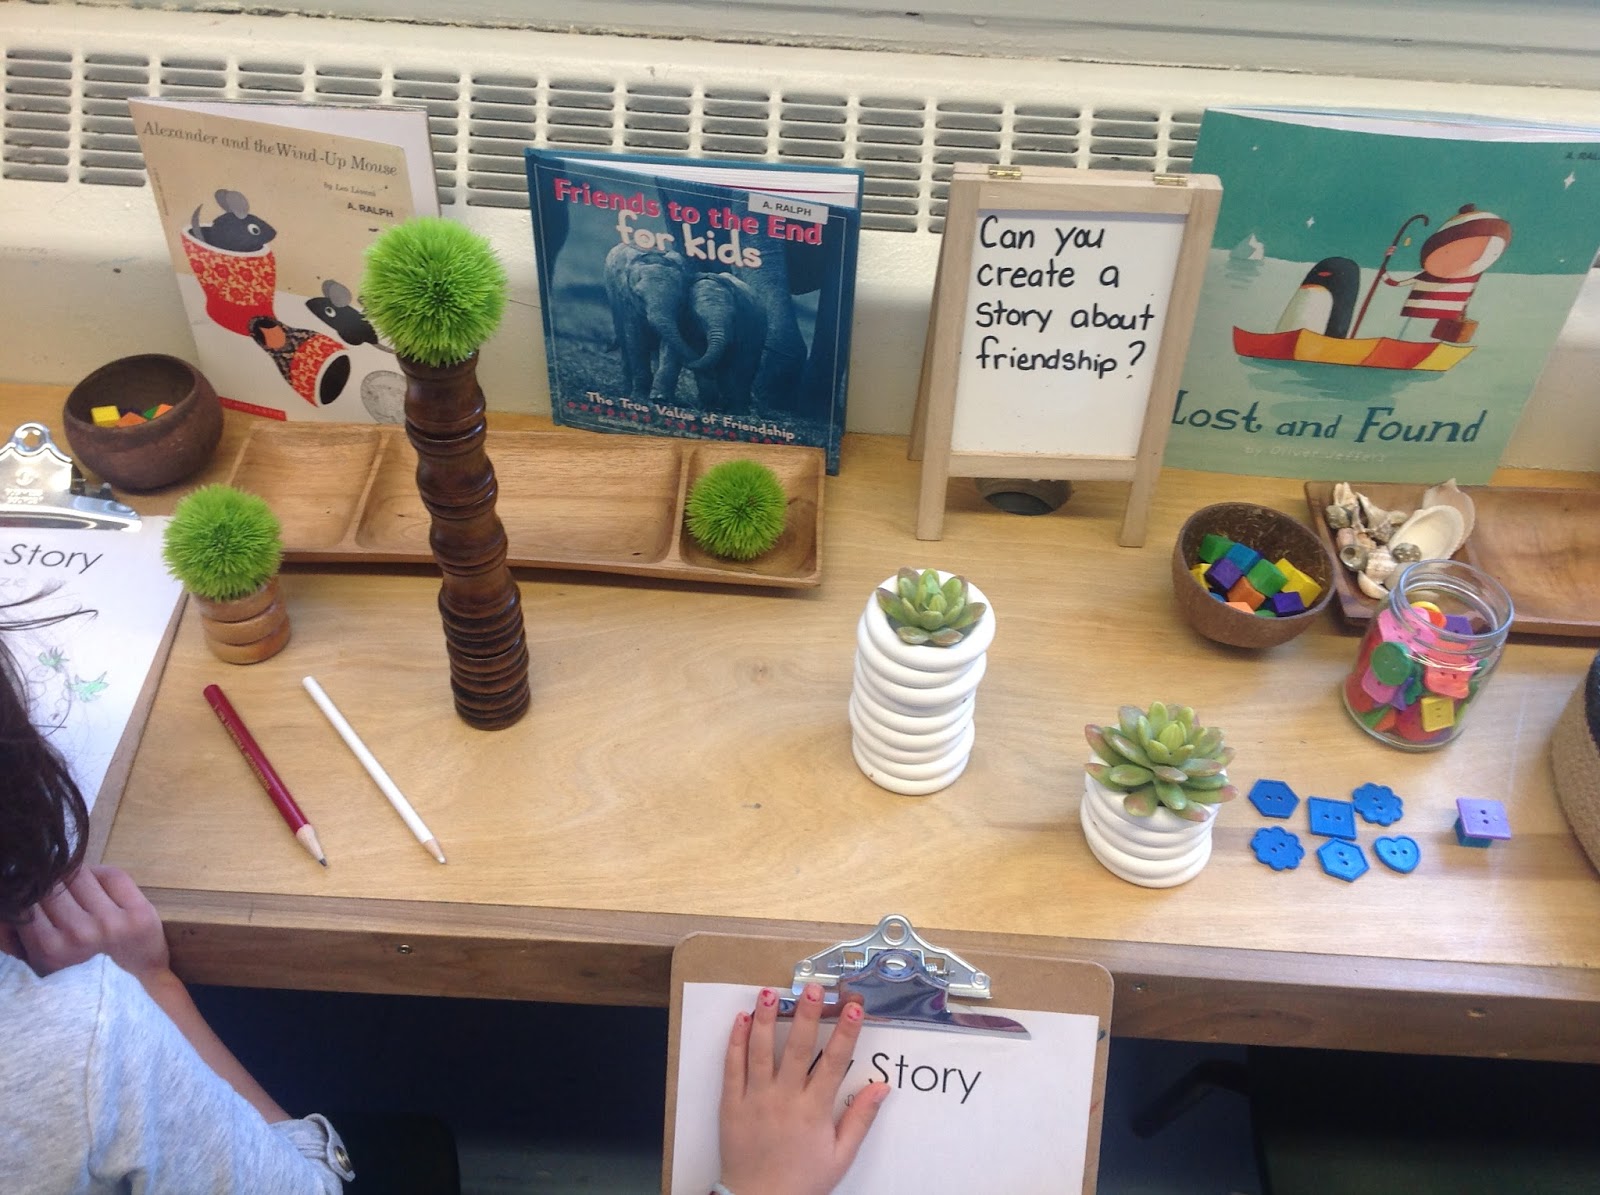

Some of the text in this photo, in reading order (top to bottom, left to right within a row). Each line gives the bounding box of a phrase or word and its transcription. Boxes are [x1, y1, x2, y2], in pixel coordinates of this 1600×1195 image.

[142, 121, 398, 176] Alexander and the Wind-Up Mouse
[347, 202, 394, 217] A. RALPH
[553, 177, 823, 246] Friends to the End
[762, 202, 811, 217] A. RALPH
[617, 210, 763, 268] for kids
[980, 215, 1105, 256] Can you
[977, 258, 1119, 288] create a
[1070, 303, 1155, 330] about
[586, 391, 614, 406] The
[619, 398, 649, 413] True
[654, 404, 696, 422] Value
[702, 414, 719, 425] of
[722, 416, 795, 442] Friendship
[1171, 390, 1488, 444] Lost and Found
[3, 543, 104, 575] Story
[868, 1051, 982, 1104] Story
